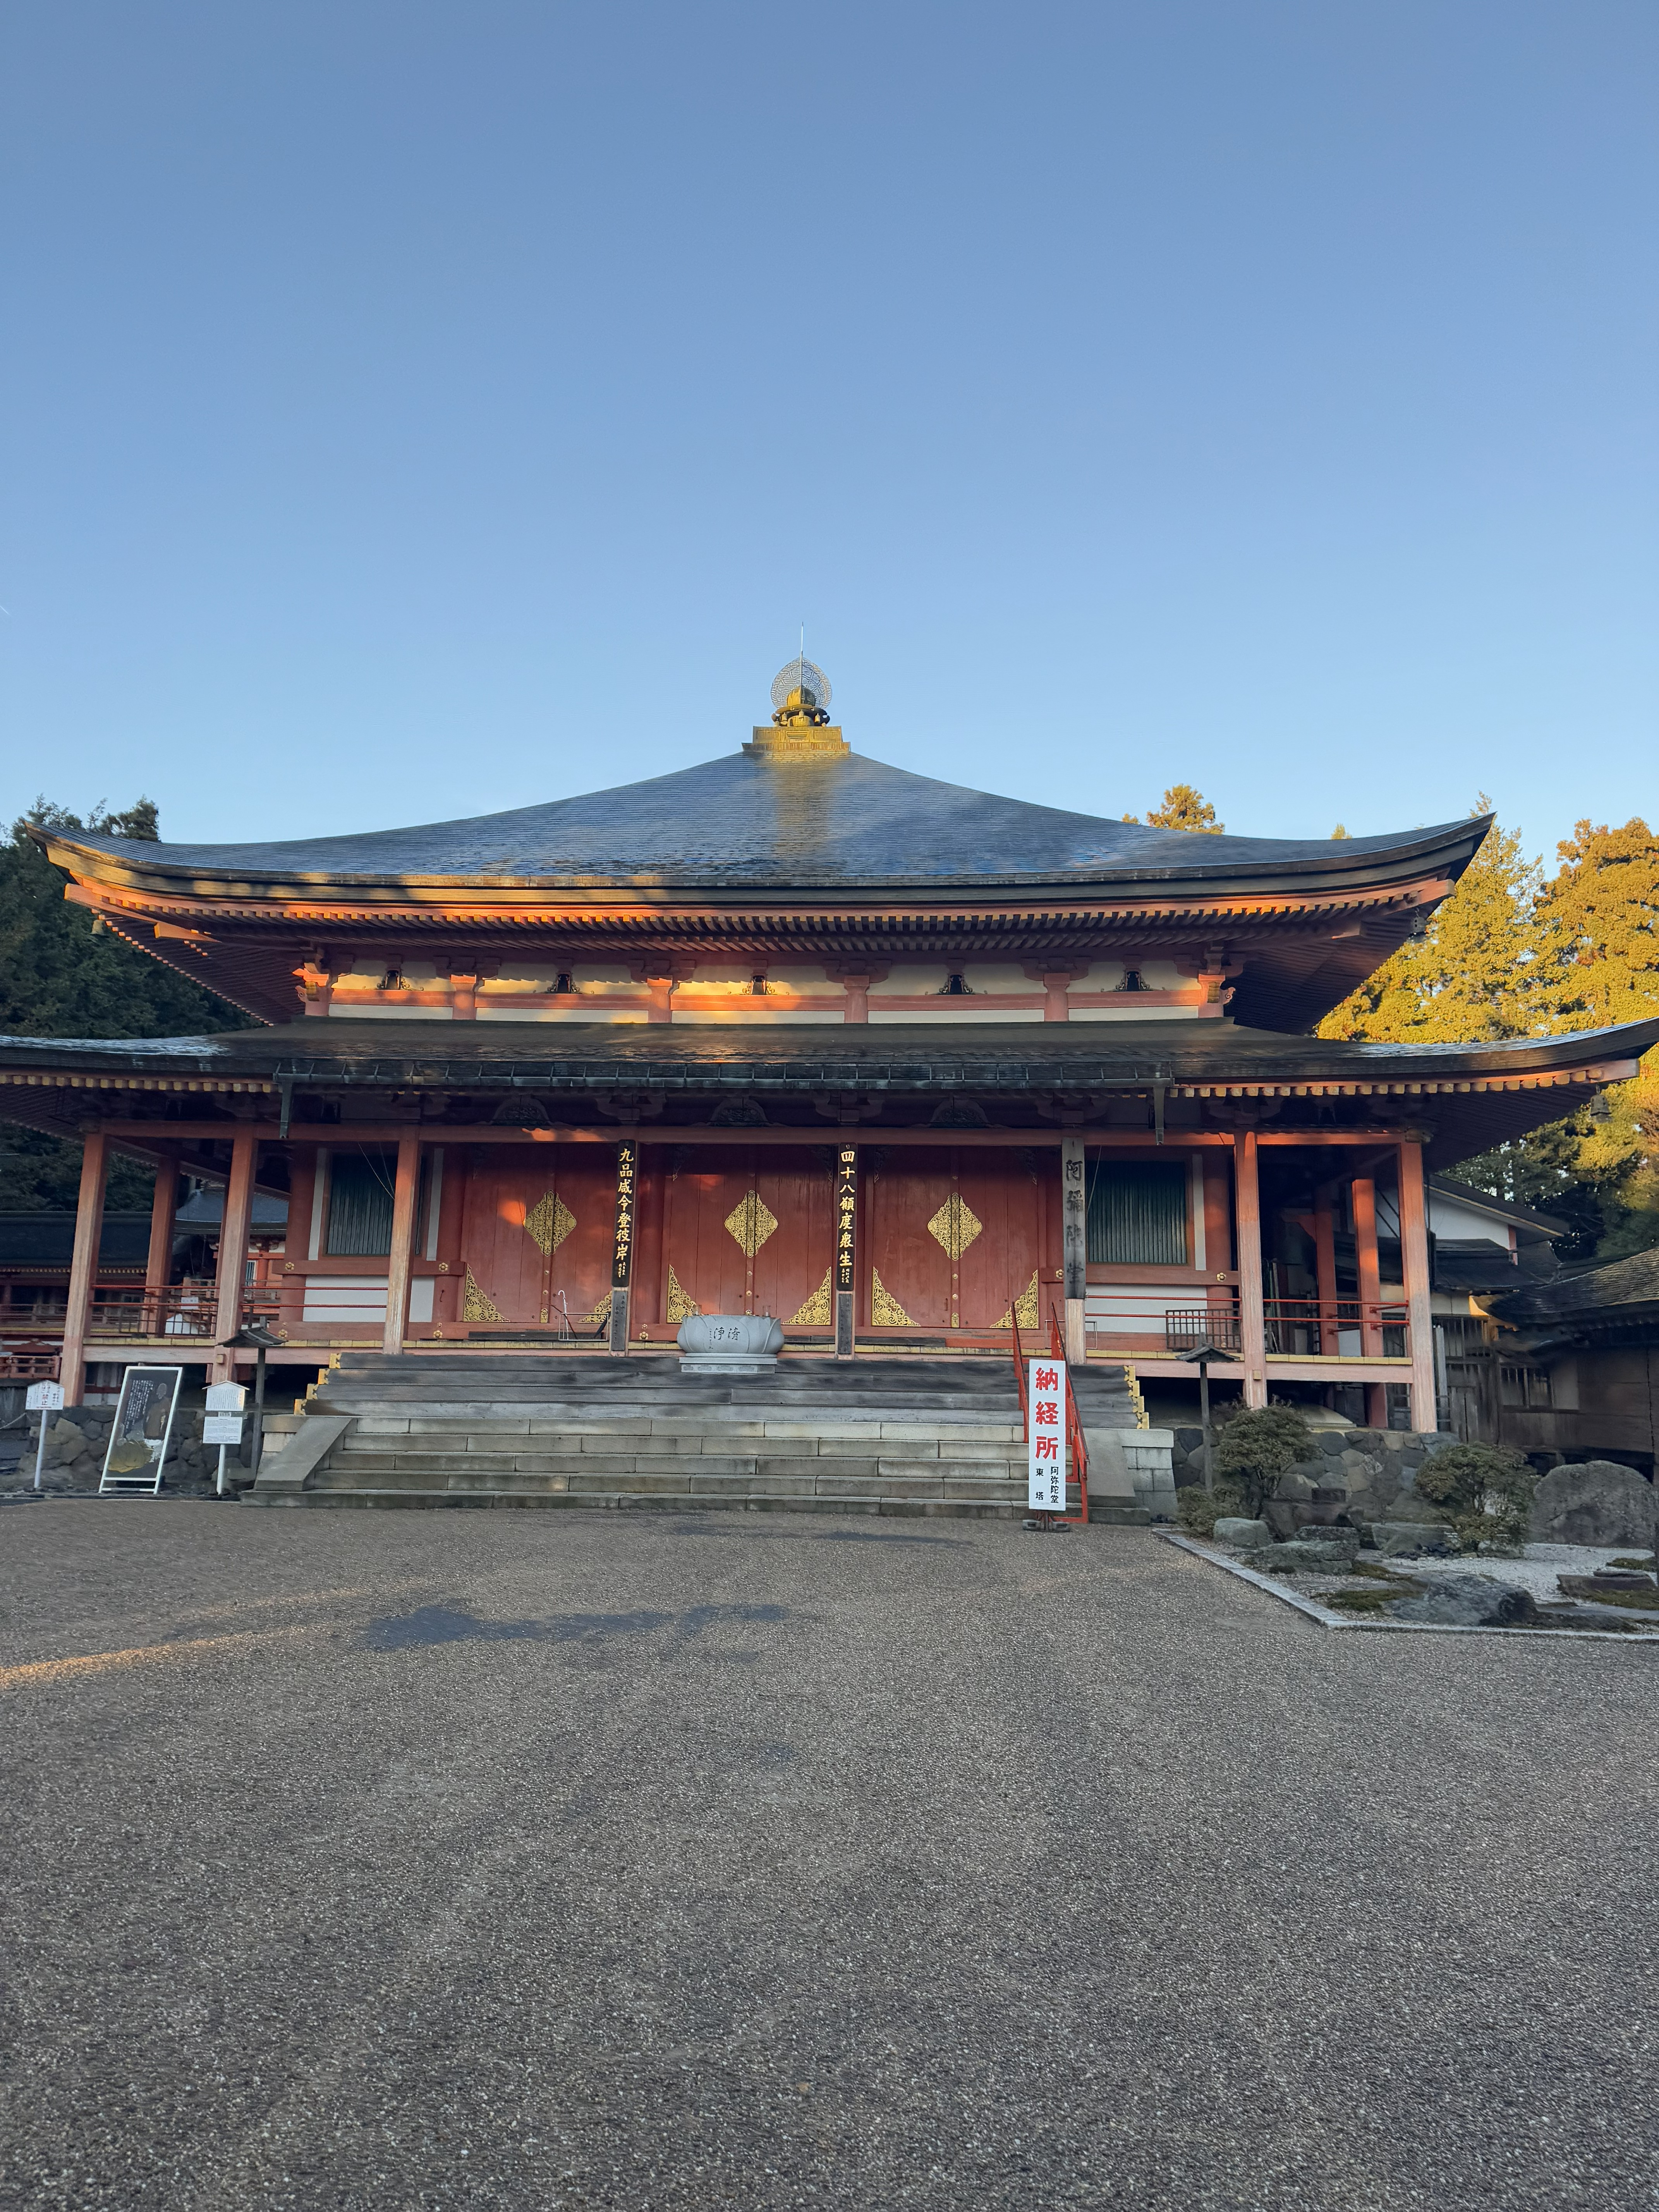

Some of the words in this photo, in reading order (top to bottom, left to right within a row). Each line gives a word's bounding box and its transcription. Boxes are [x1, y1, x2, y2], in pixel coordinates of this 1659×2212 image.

[1036, 1367, 1059, 1460] 納経所
[1036, 1468, 1044, 1500] 東塔
[1051, 1466, 1059, 1503] 阿弥陀堂
